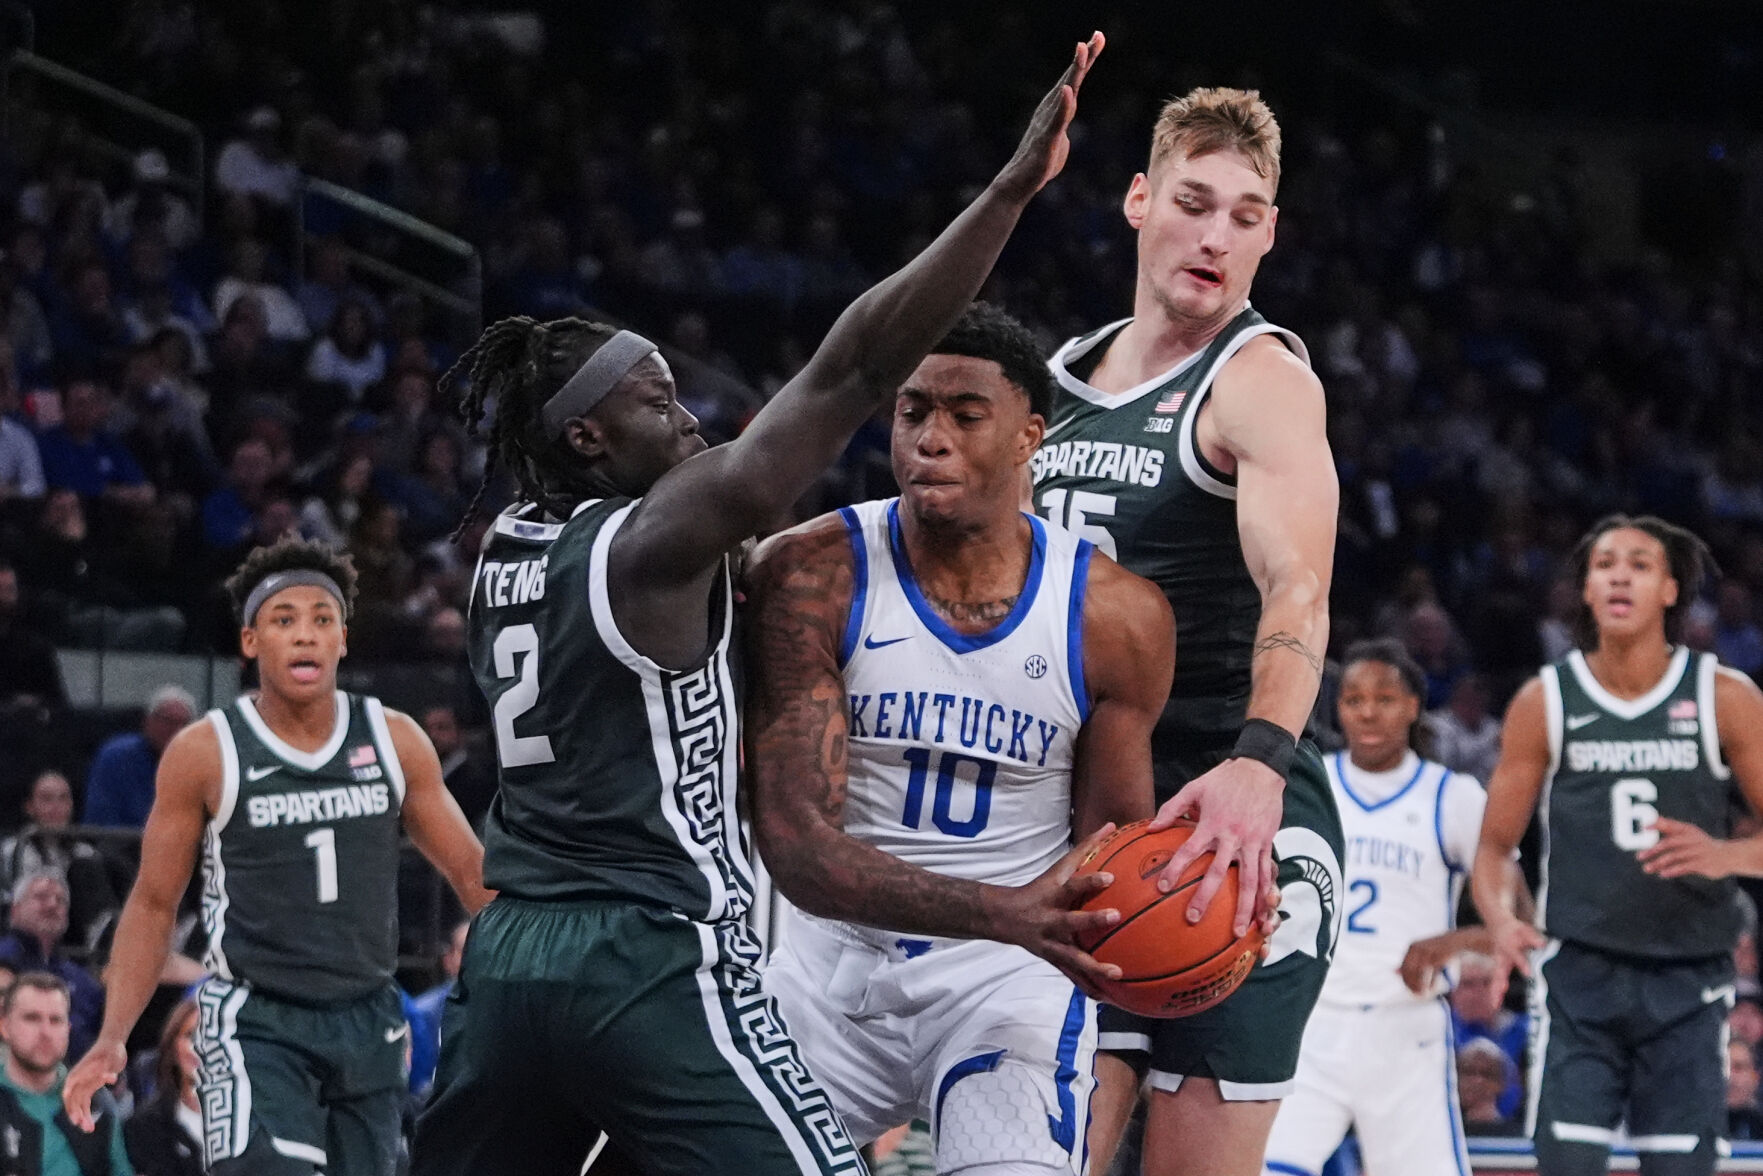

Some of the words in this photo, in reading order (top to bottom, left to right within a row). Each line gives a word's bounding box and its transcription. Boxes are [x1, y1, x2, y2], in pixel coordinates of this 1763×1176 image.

[1030, 440, 1165, 488] SPARTANS
[1041, 488, 1118, 563] 15
[482, 554, 549, 608] TENG
[493, 623, 556, 769] 2
[1025, 654, 1047, 679] SEC
[850, 691, 1058, 767] KENTUCKY
[1567, 739, 1699, 773] SPARTANS
[247, 782, 389, 828] SPARTANS
[902, 747, 998, 839] 10
[1611, 777, 1661, 852] 6
[304, 827, 339, 904] 1
[1347, 879, 1379, 934] 2
